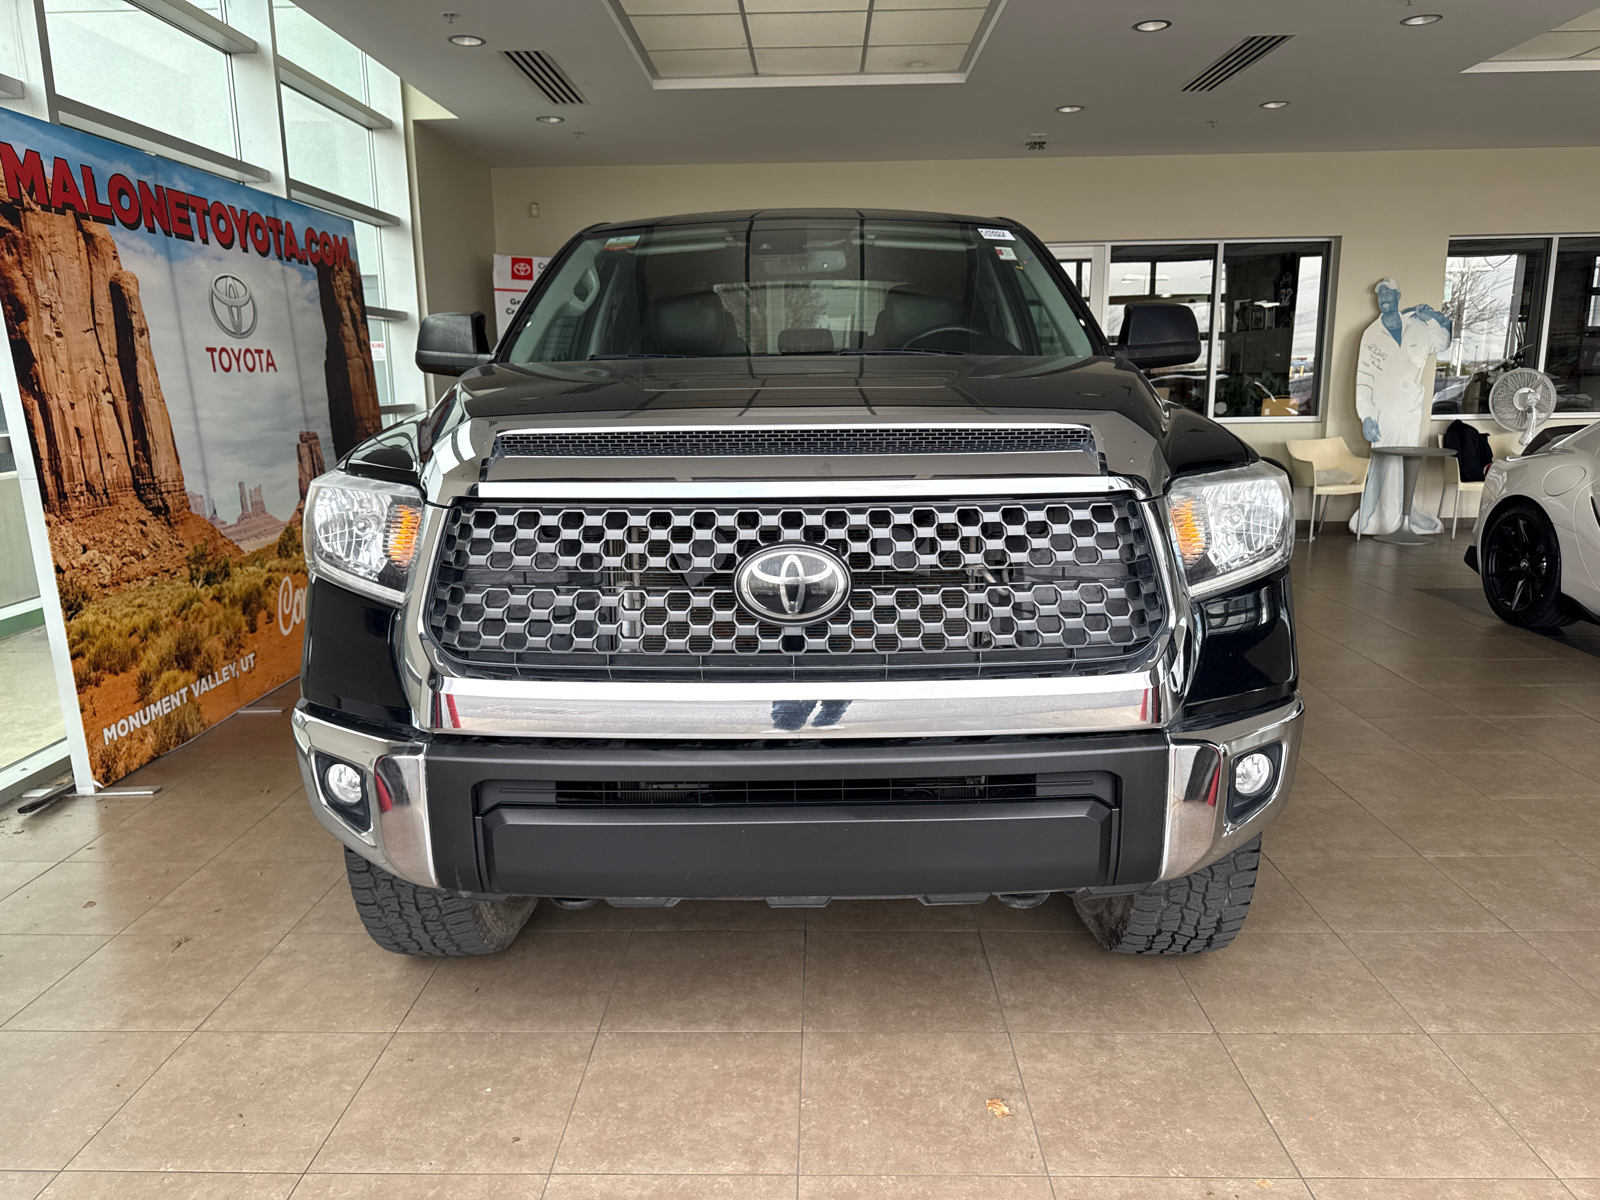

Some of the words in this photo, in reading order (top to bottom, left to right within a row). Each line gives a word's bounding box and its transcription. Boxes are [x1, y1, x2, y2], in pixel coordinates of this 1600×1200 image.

[0, 141, 353, 270] MALONETOYOTA.COM
[205, 347, 278, 373] TOYOTA
[103, 686, 188, 745] MONUMENT
[190, 660, 239, 697] VALLEY,
[240, 652, 255, 673] UT
